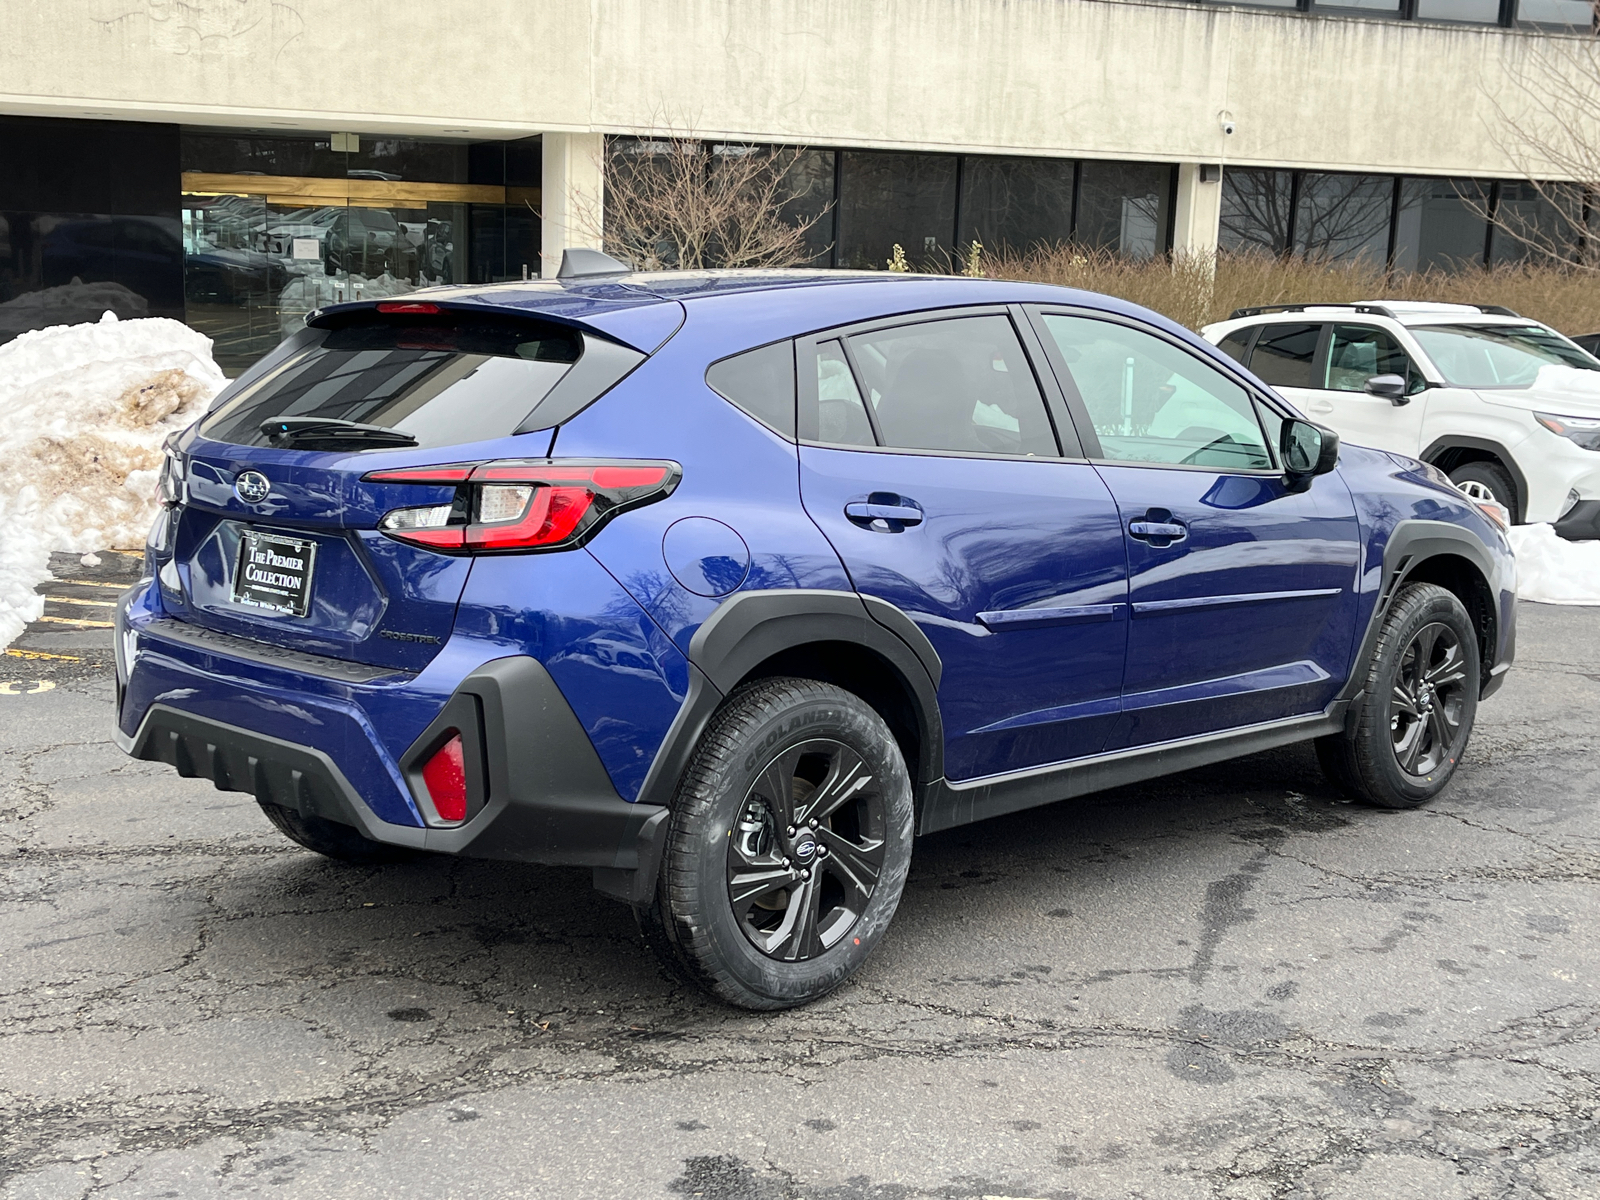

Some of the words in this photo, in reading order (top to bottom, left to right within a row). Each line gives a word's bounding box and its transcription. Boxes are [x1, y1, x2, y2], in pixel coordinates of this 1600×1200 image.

[249, 547, 267, 563] THE
[266, 549, 304, 571] PREMIER
[245, 563, 302, 589] COLLECTION
[379, 630, 442, 645] CROSSTREK
